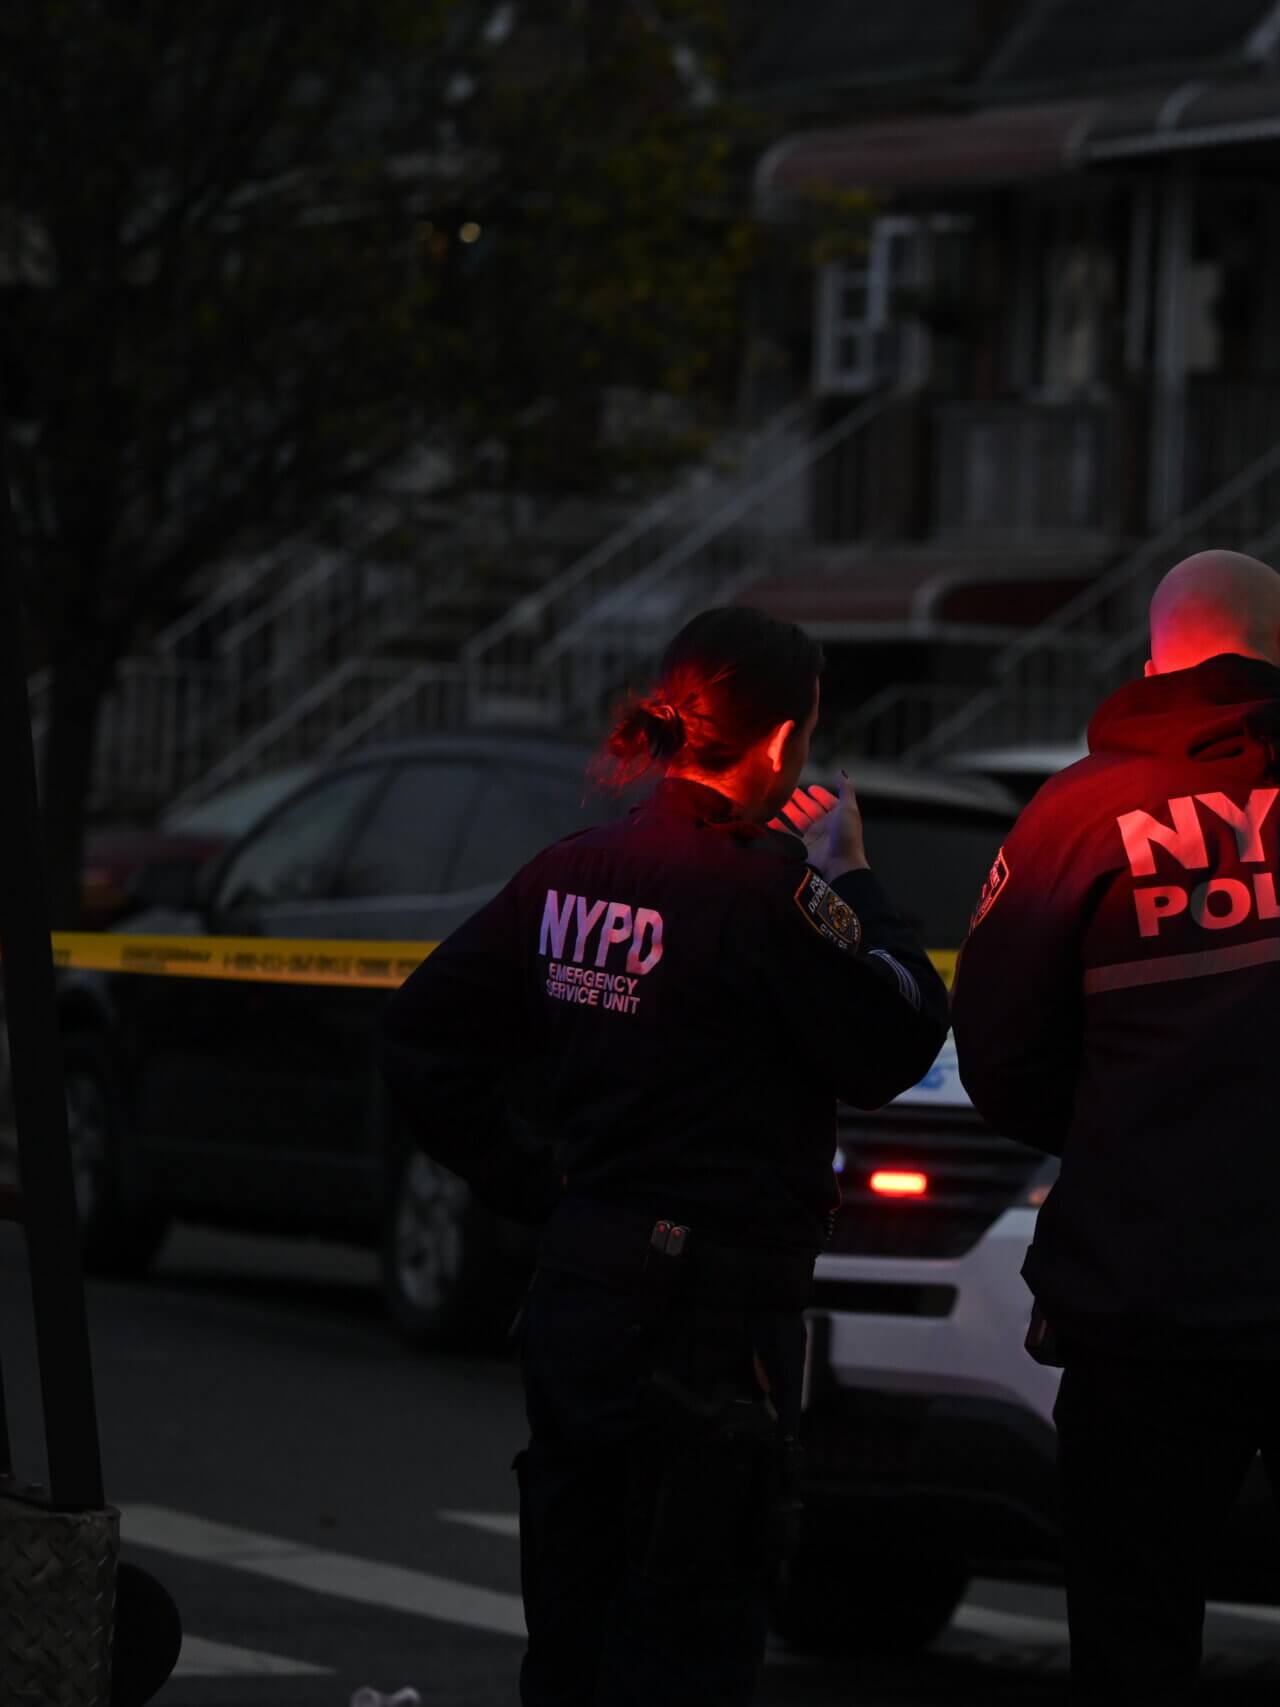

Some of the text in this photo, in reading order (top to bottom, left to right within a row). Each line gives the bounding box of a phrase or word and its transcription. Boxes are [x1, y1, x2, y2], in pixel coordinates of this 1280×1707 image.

[537, 888, 665, 976] NYPD
[549, 962, 639, 994] EMERGENCY
[545, 980, 641, 1015] SERVICE UNIT
